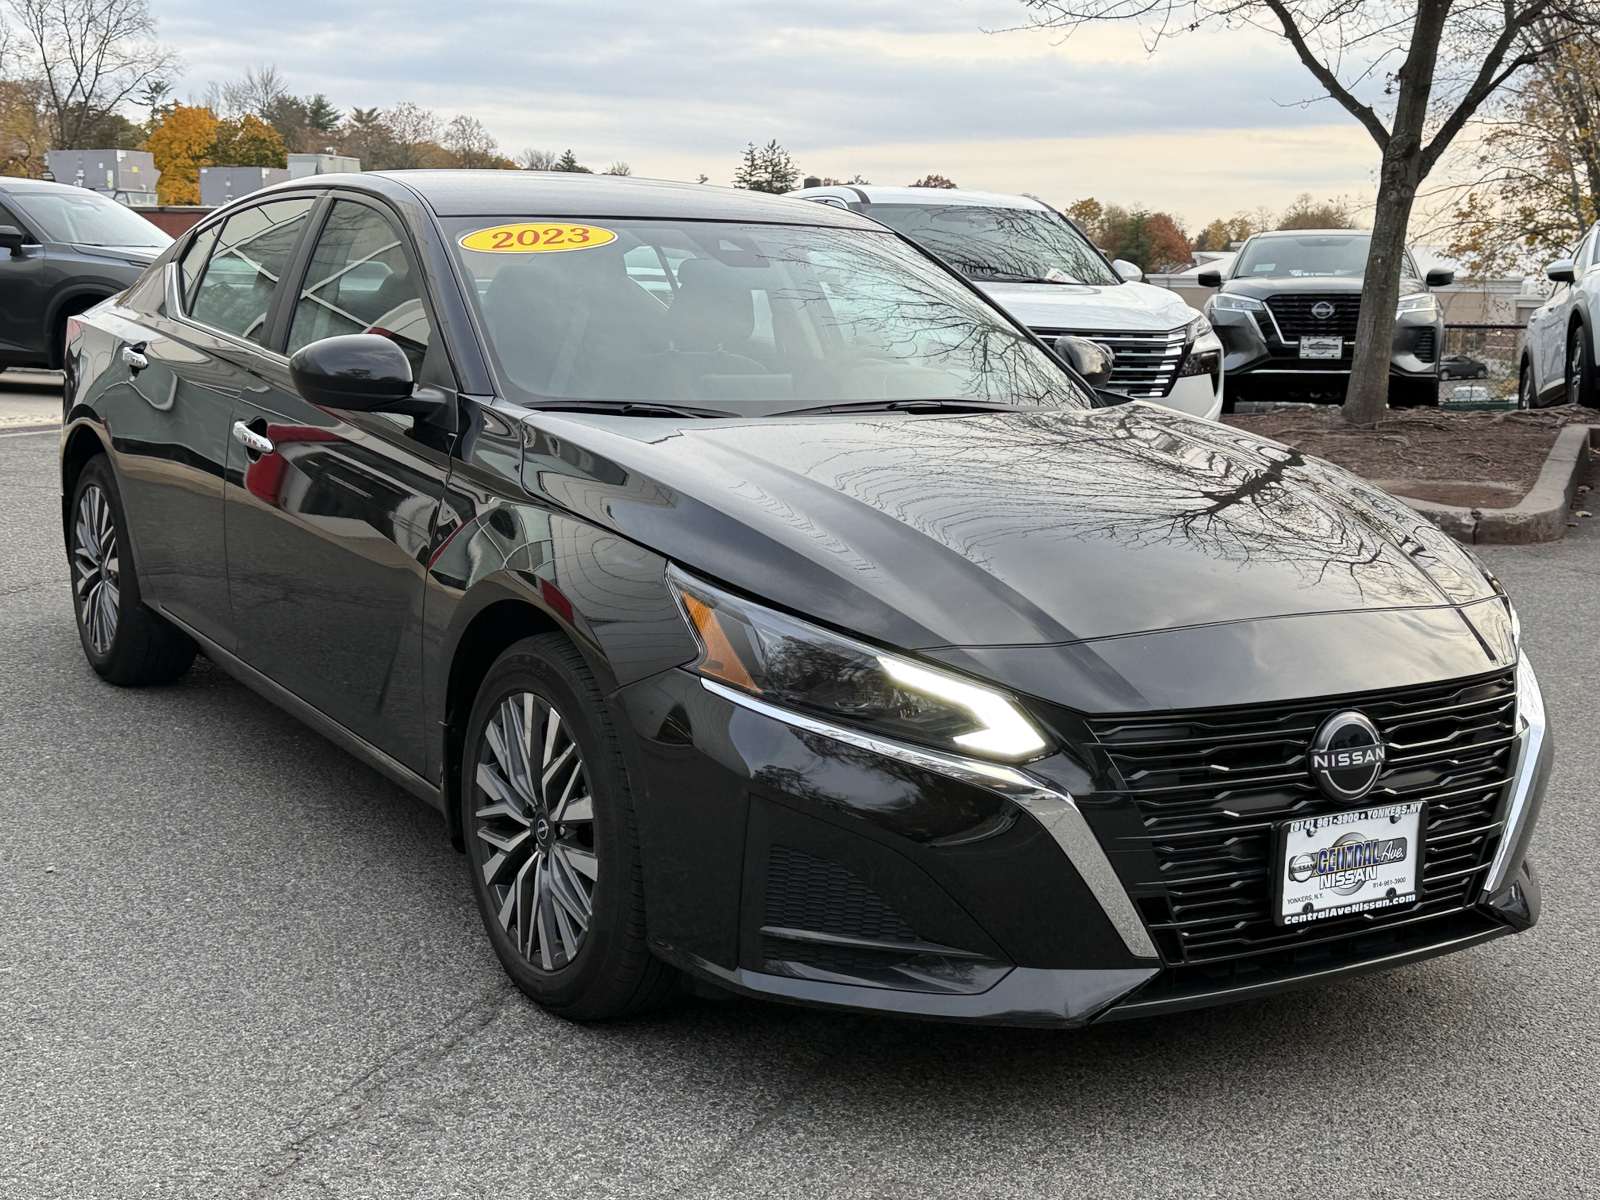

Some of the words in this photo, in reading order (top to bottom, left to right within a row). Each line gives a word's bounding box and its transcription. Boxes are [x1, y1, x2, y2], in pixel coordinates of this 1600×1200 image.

[492, 228, 590, 249] 2023
[1314, 746, 1385, 768] NISSAN
[1318, 840, 1379, 874] CENTRAL
[1380, 841, 1404, 861] Ave.
[1319, 866, 1378, 890] NISSAN
